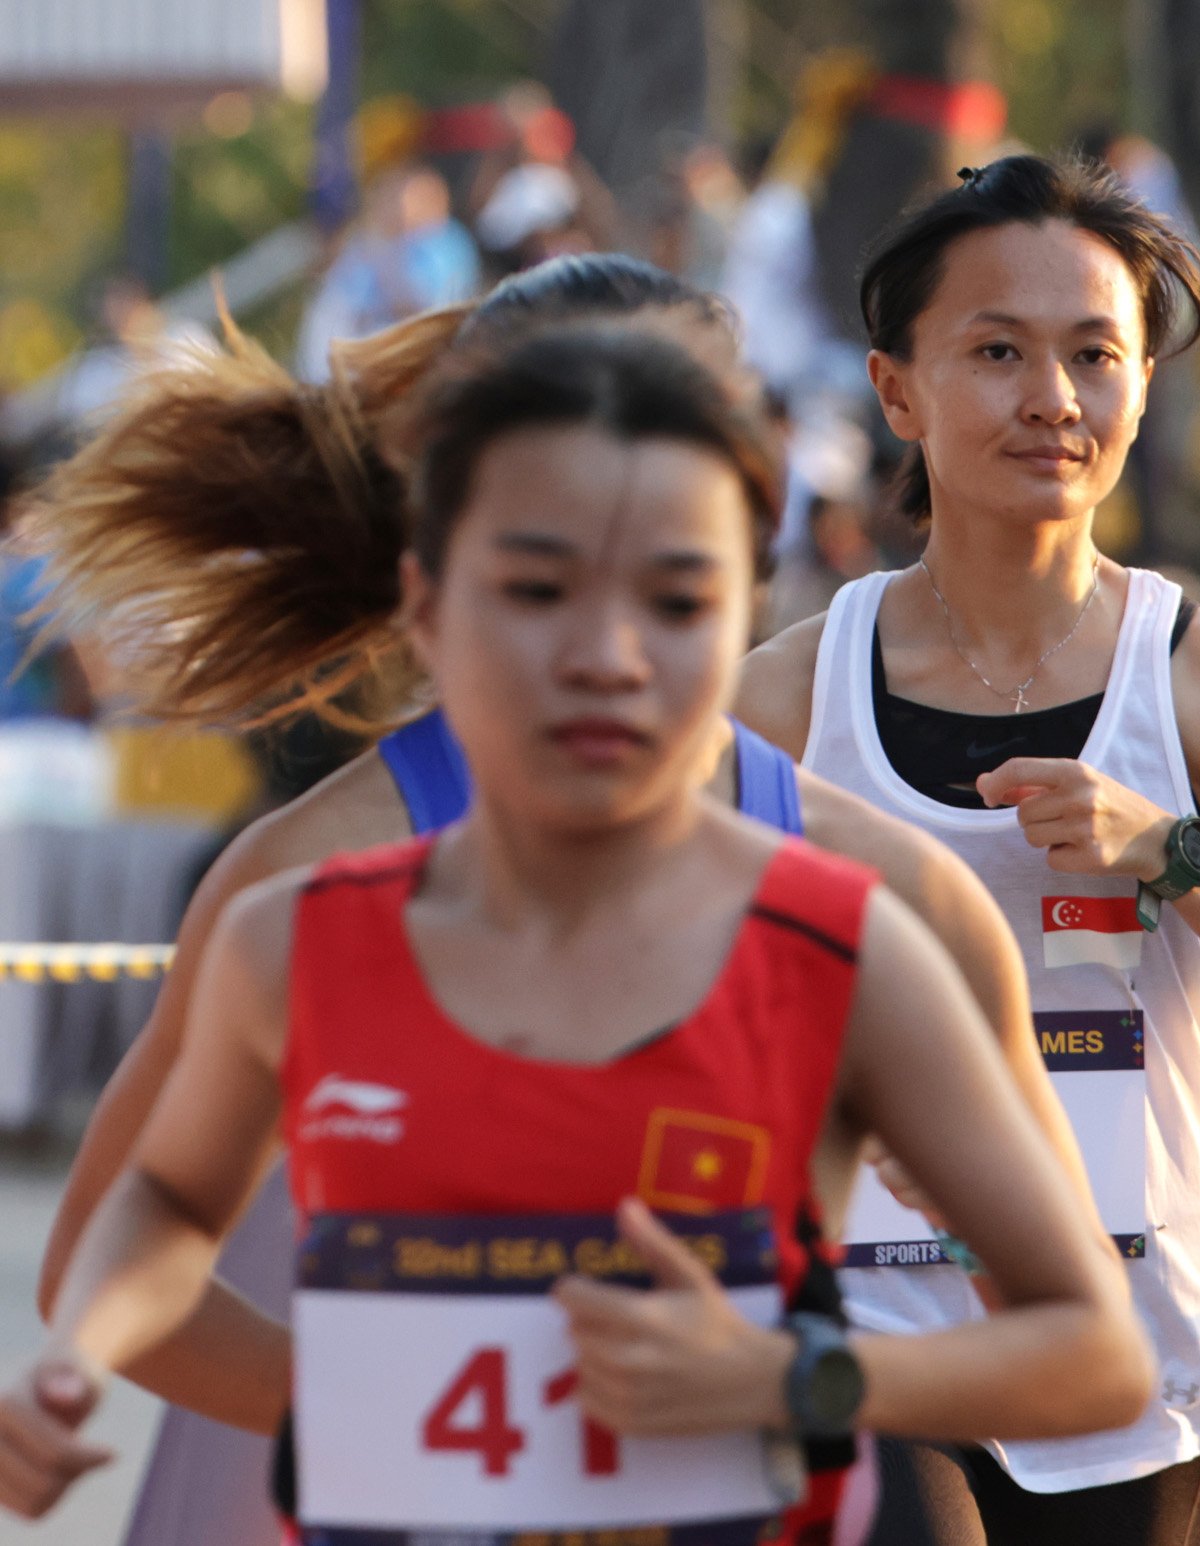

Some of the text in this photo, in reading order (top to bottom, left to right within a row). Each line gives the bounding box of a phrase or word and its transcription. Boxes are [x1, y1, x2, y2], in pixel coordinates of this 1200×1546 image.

[1041, 1030, 1104, 1054] MES
[488, 1235, 567, 1278] SEA
[574, 1233, 727, 1276] GAS
[874, 1242, 940, 1265] SPORTS
[419, 1346, 620, 1478] 41
